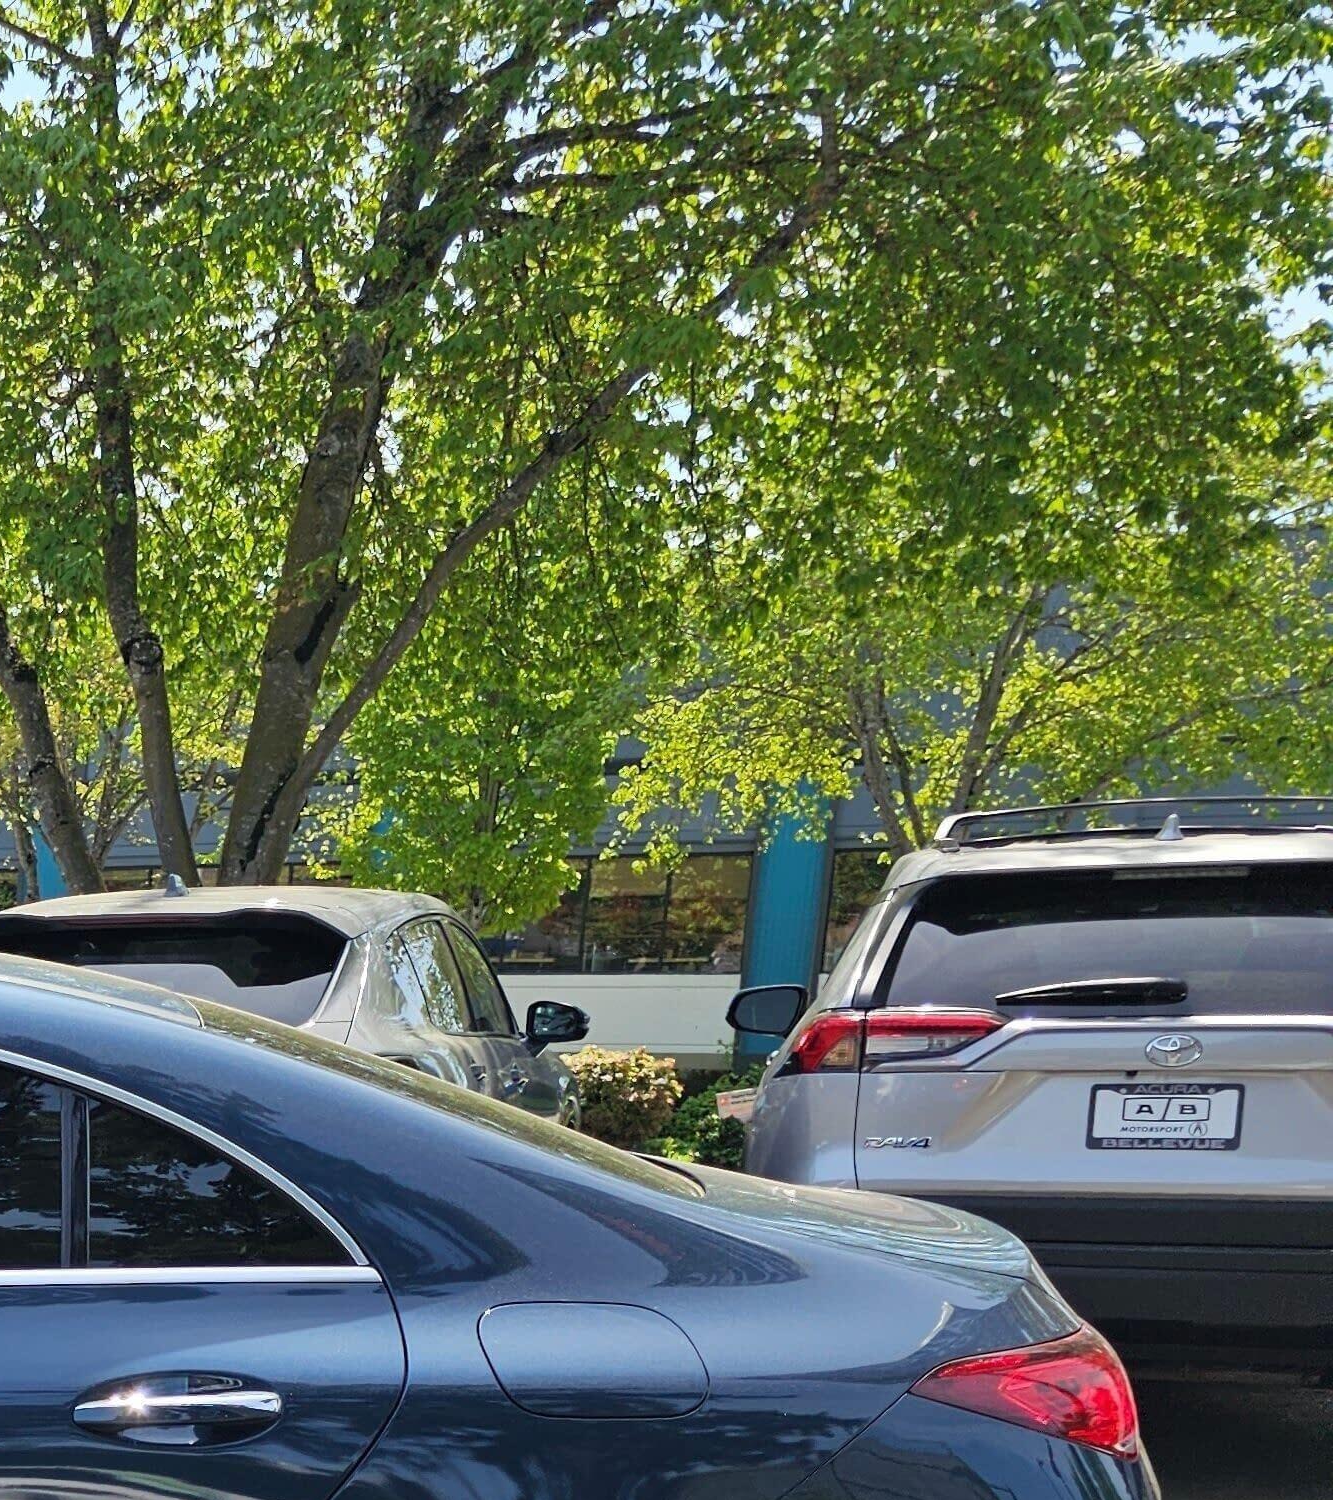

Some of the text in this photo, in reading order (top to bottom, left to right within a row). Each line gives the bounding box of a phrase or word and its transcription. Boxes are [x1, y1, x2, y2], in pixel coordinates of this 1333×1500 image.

[1133, 1084, 1202, 1094] ACURA
[1136, 1104, 1197, 1115] A B
[1119, 1125, 1184, 1134] MOTORSPORT
[863, 1136, 932, 1149] RAV4
[1101, 1138, 1226, 1149] BELLEVUE
